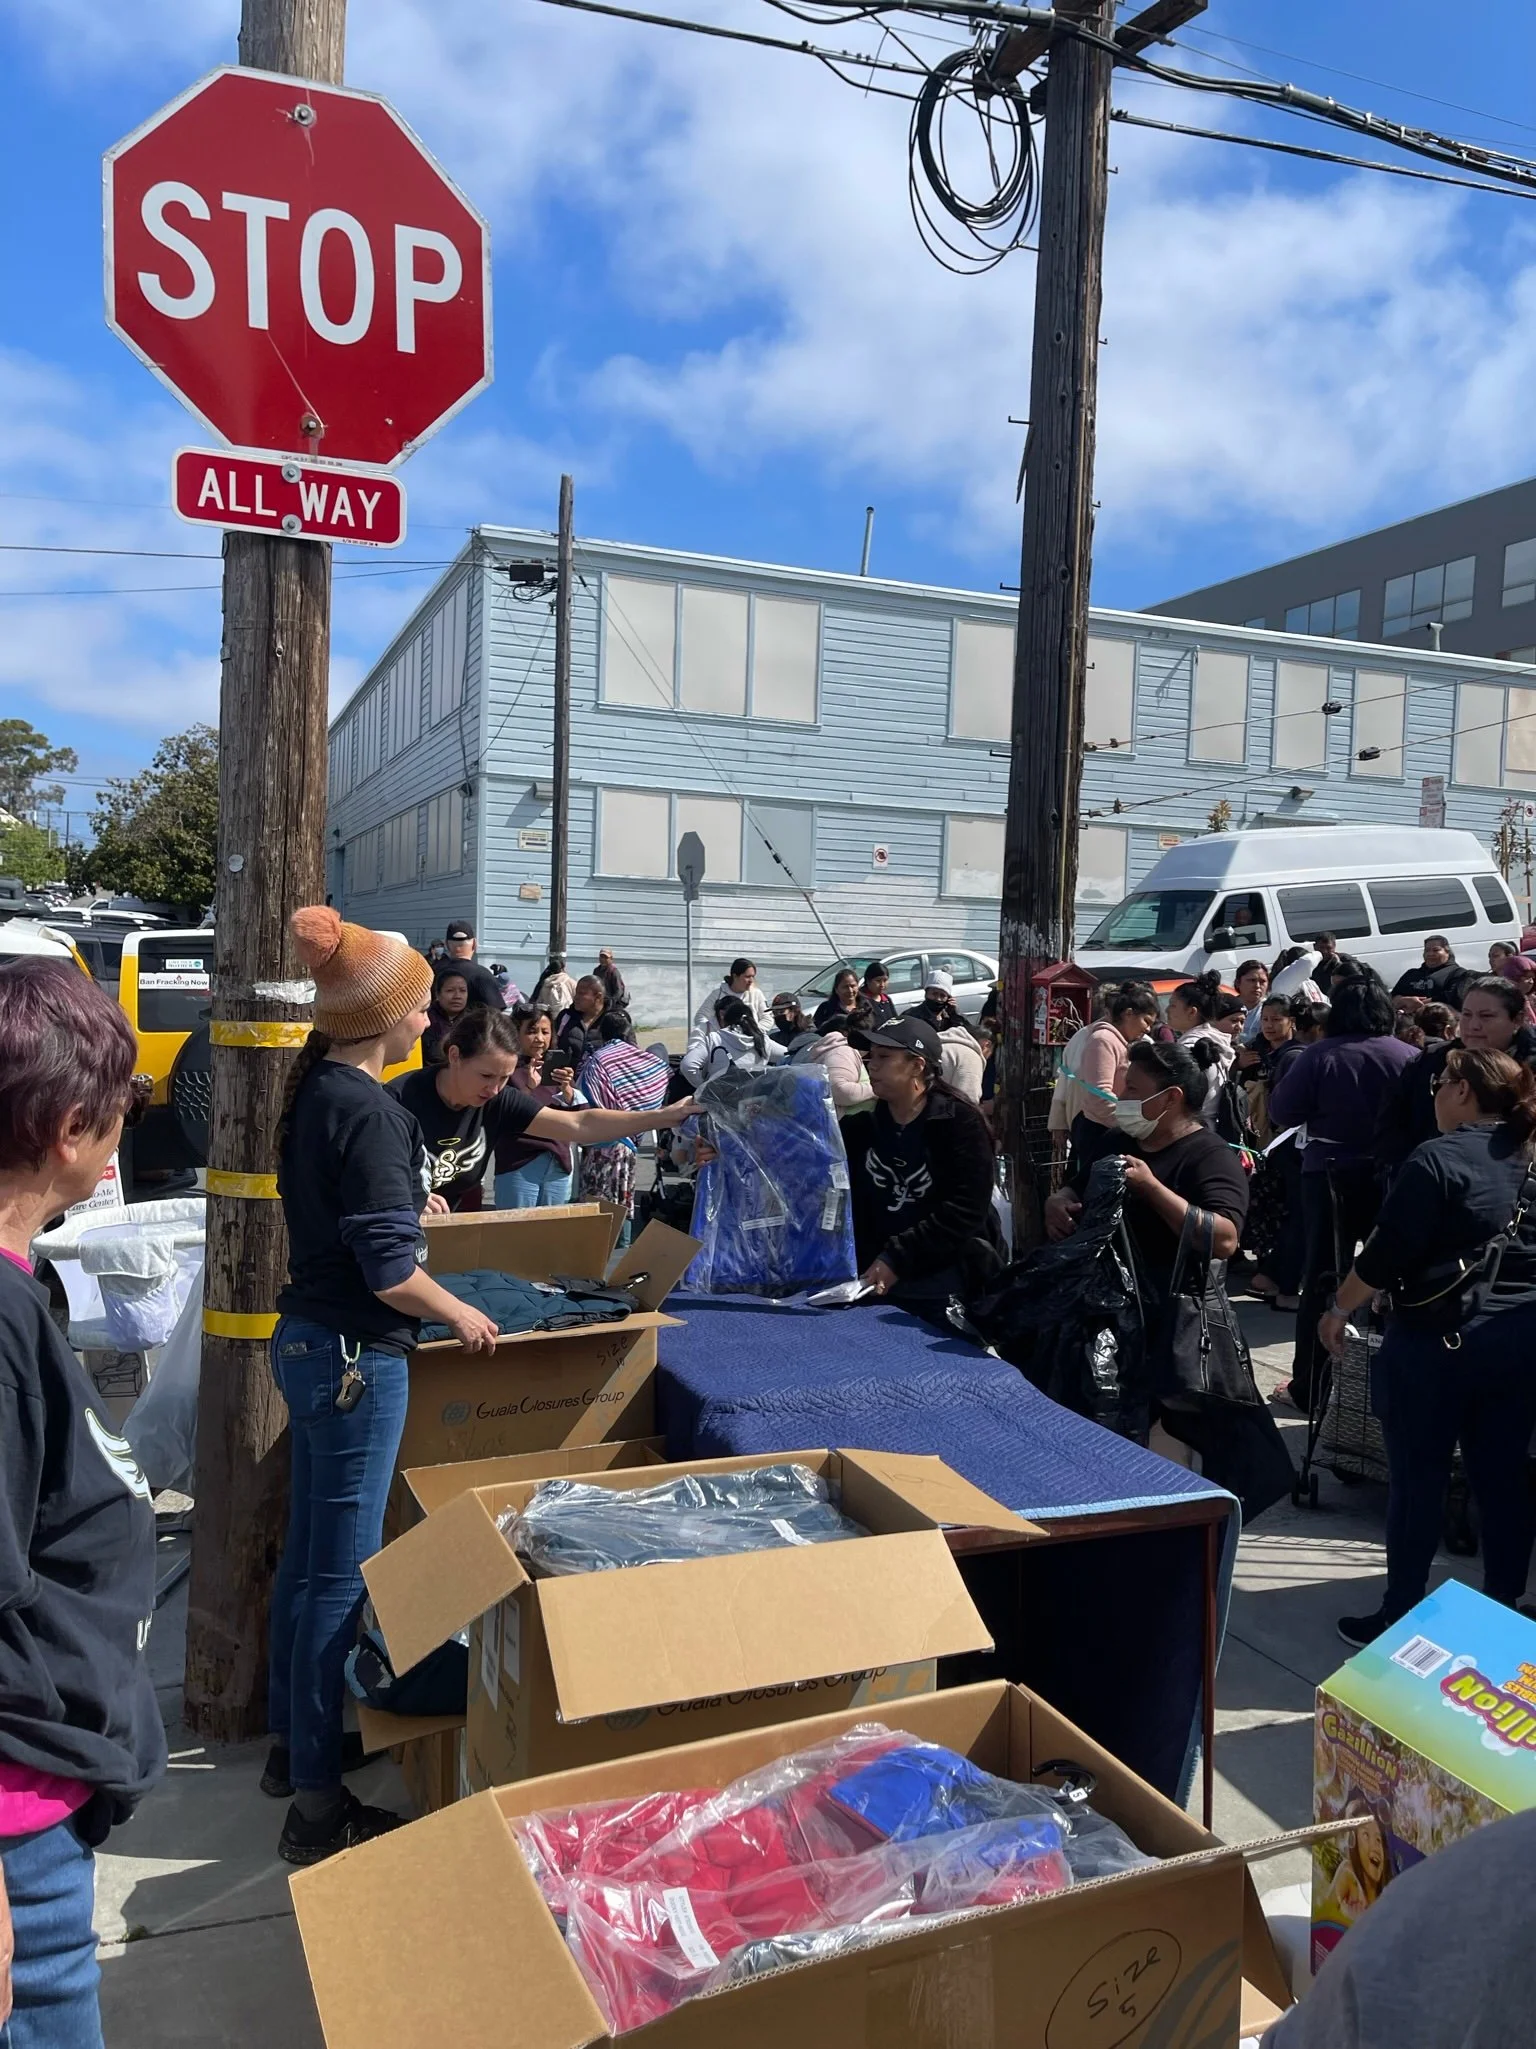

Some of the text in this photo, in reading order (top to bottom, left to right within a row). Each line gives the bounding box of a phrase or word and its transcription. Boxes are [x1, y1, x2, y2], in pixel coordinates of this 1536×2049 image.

[137, 181, 463, 354] STOP
[197, 468, 382, 530] ALL WAY
[156, 979, 190, 988] Fracking
[88, 1199, 114, 1208] Center
[476, 1388, 624, 1419] Guala Closures Group
[1118, 1992, 1136, 2018] 5
